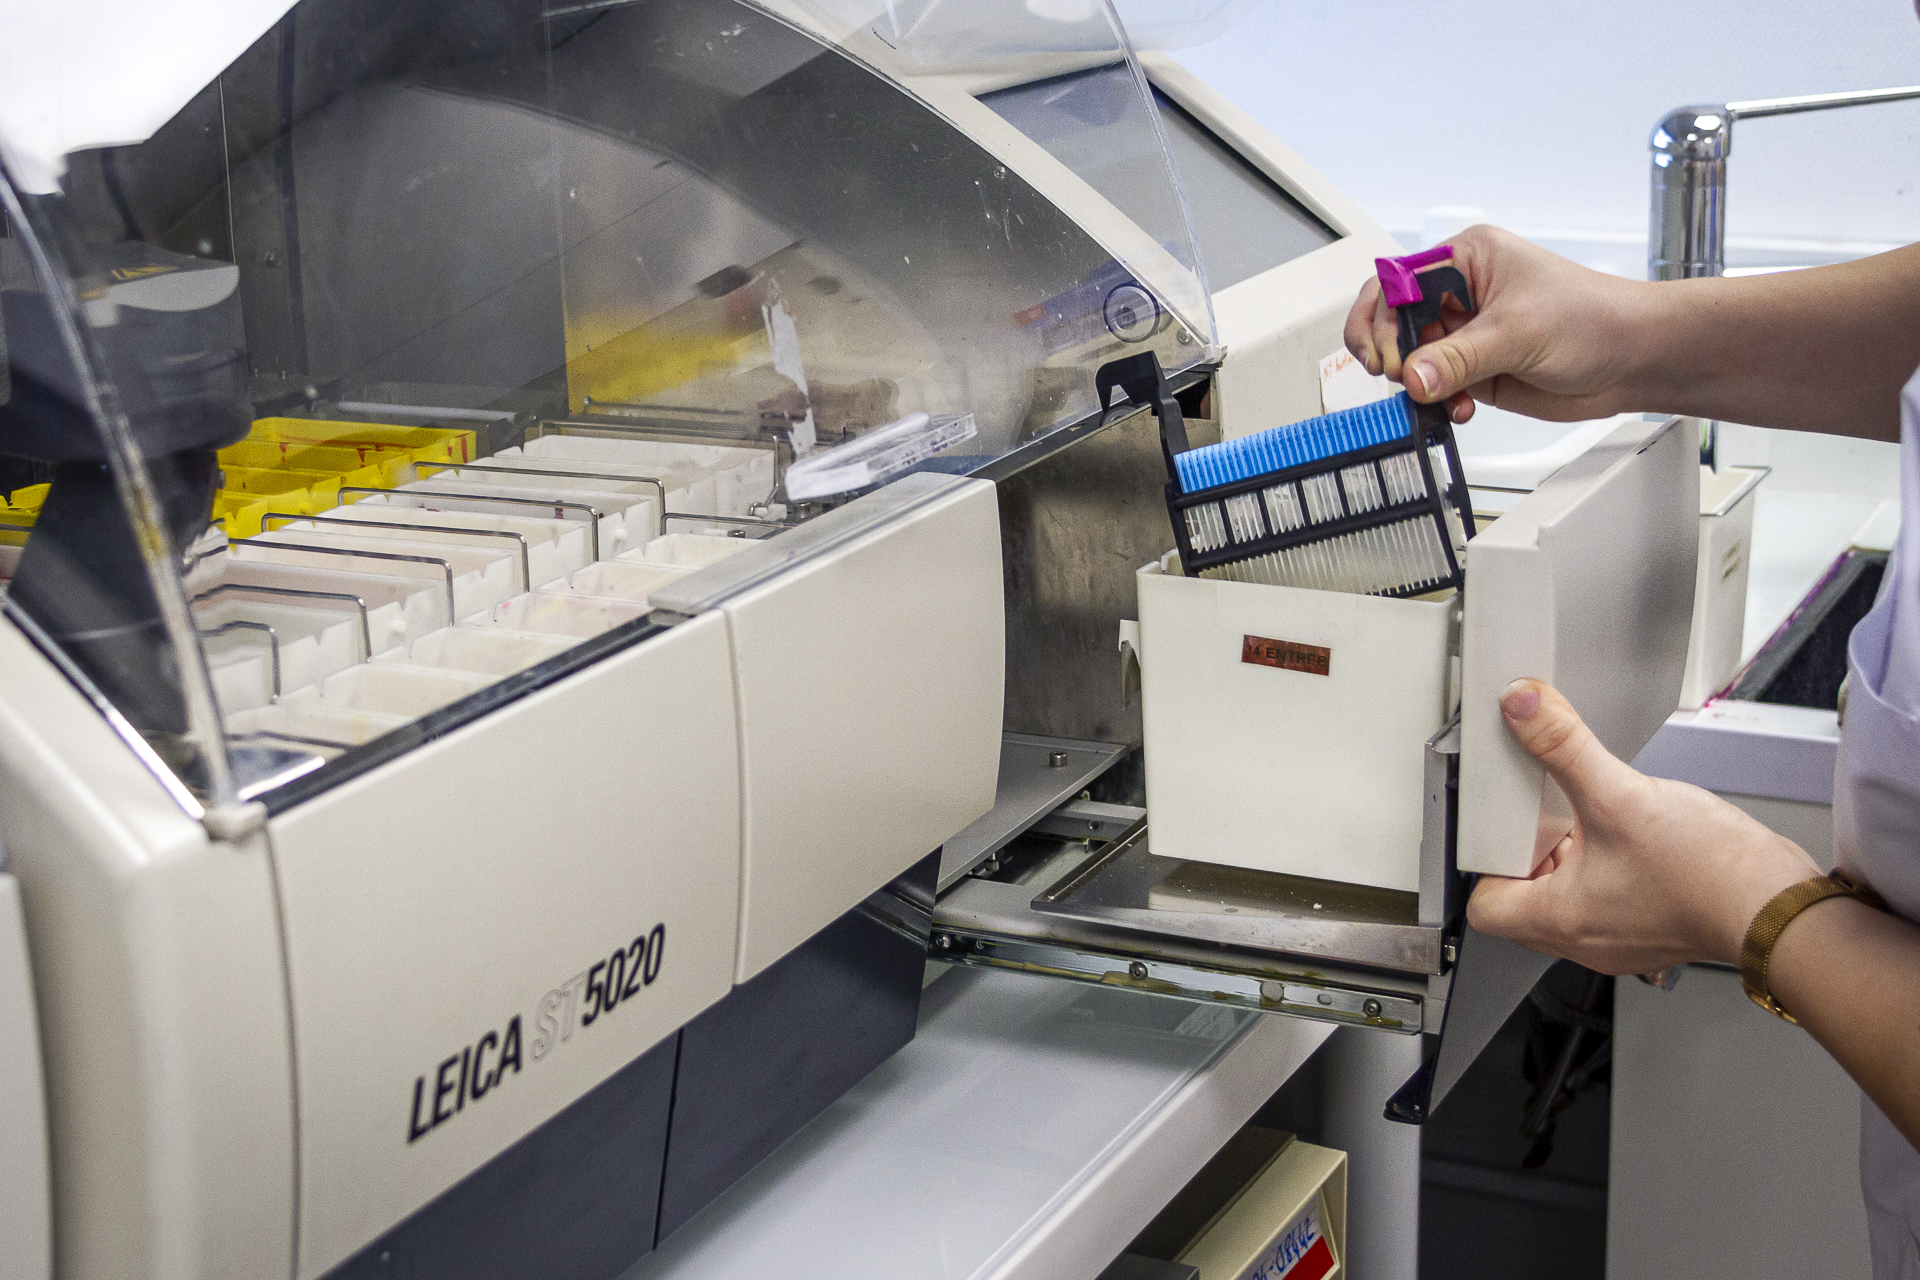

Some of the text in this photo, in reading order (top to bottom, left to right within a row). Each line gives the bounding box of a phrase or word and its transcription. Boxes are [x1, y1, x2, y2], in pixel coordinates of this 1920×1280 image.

[406, 921, 665, 1144] LEICA ST 5020
